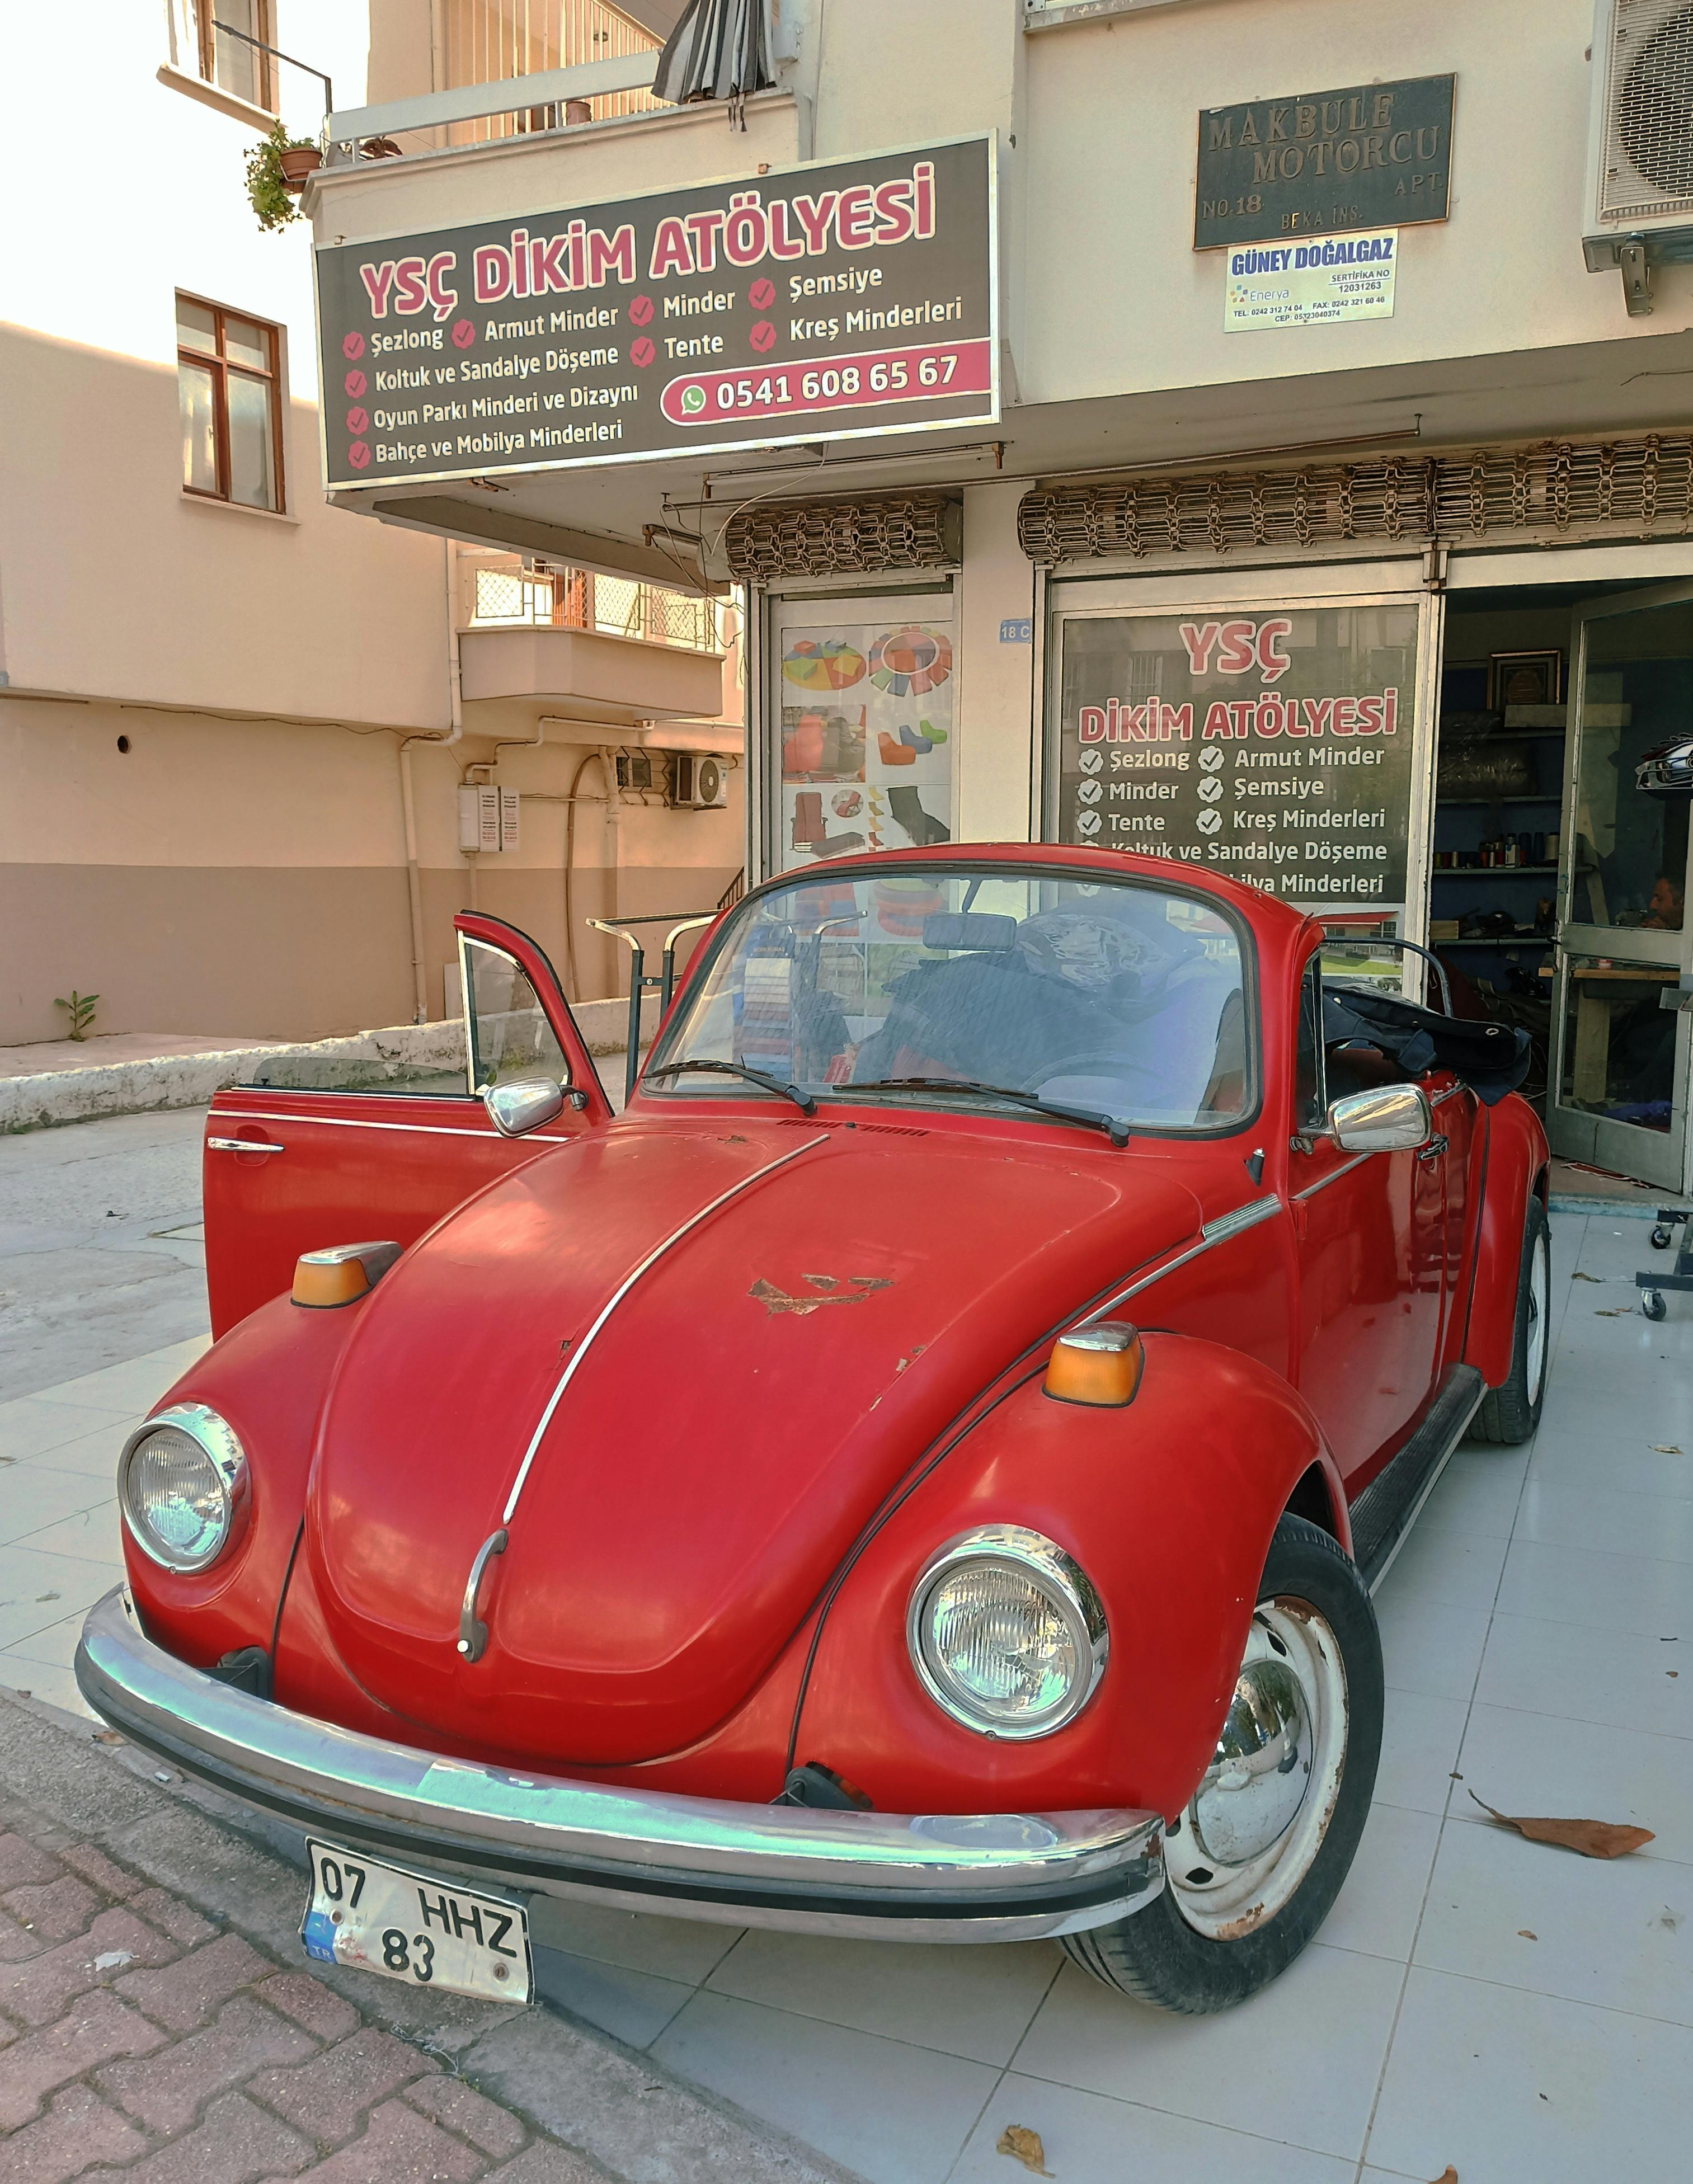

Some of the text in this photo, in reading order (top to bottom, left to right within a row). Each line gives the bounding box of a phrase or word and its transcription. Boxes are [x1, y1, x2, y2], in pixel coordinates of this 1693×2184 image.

[1208, 93, 1396, 151] MAKBULE
[1253, 126, 1441, 183] MOTORCU
[1394, 173, 1443, 196] APT.
[1281, 210, 1324, 229] BEKA
[359, 161, 936, 322] YSÇ DİKİM ATÖLYESİ
[1232, 238, 1393, 276] GÜNEY DOĞALGAZ
[789, 267, 882, 303] Şemsiye
[1332, 270, 1374, 282] SERTİFİKA
[1339, 281, 1381, 293] 12031263
[663, 291, 736, 318] Minder
[1250, 290, 1289, 302] Enerya
[485, 307, 619, 341] Armut Minder
[790, 297, 962, 342] Kreş Minderleri
[371, 328, 444, 357] Şezlong
[665, 334, 723, 359] Tente
[375, 347, 618, 392] Koltuk ve Sandalye Döşeme
[717, 355, 958, 410] 0541 608 65 67
[374, 384, 638, 431] Oyun Parkı Minderi ve Dizaynı
[376, 420, 622, 464] Bahçe ve Mobilya Minderleri
[1001, 625, 1029, 638] 18 C
[1179, 618, 1292, 684] YSÇ
[1079, 688, 1398, 743] DİKİM ATÖLYESİ
[1110, 750, 1191, 772] Şezlong
[1235, 746, 1385, 767] Armut Minder
[1109, 782, 1179, 800] Minder
[1235, 777, 1324, 800] Şemsiye
[1108, 813, 1165, 831] Tente
[1234, 808, 1385, 832] Kreş Minderleri
[1179, 845, 1202, 859] ve
[1208, 841, 1298, 864] Sandalye
[1305, 841, 1387, 864] Döşeme
[1282, 874, 1383, 893] Minderleri
[321, 1857, 517, 1958] 07 HHZ
[312, 1945, 331, 1959] TR
[382, 1928, 435, 1981] 83
